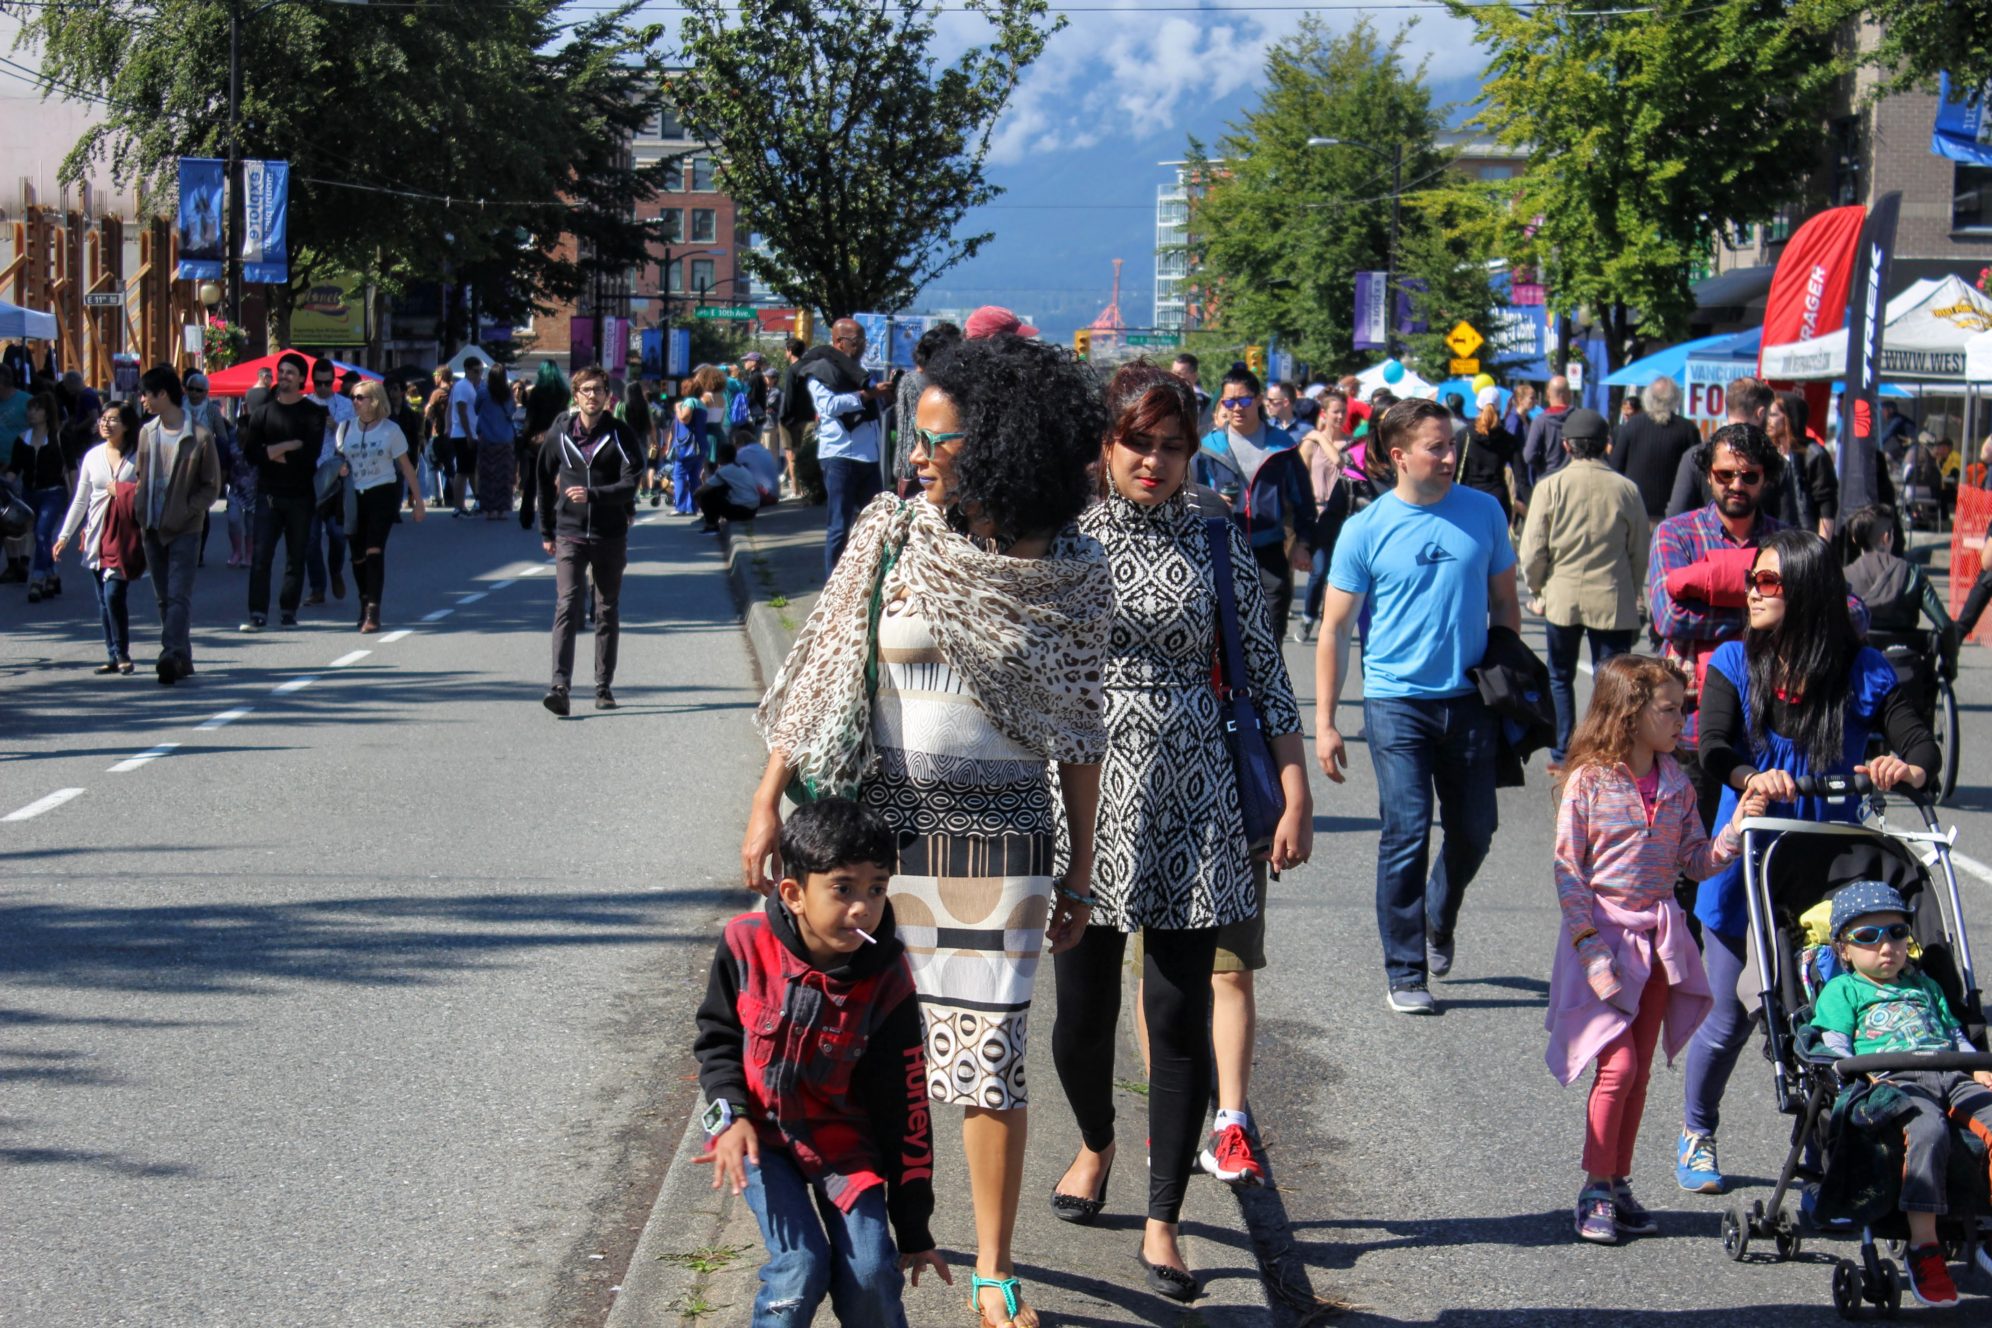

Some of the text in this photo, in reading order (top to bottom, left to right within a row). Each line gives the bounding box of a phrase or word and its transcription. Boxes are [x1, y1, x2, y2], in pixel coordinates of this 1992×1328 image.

[1801, 264, 1826, 341] RAGER
[1863, 242, 1882, 389] TREK
[1691, 366, 1757, 380] VANCOUVE
[1884, 350, 1967, 373] WWW.WEST
[1690, 383, 1727, 416] FO
[903, 1045, 929, 1148] Hurley
